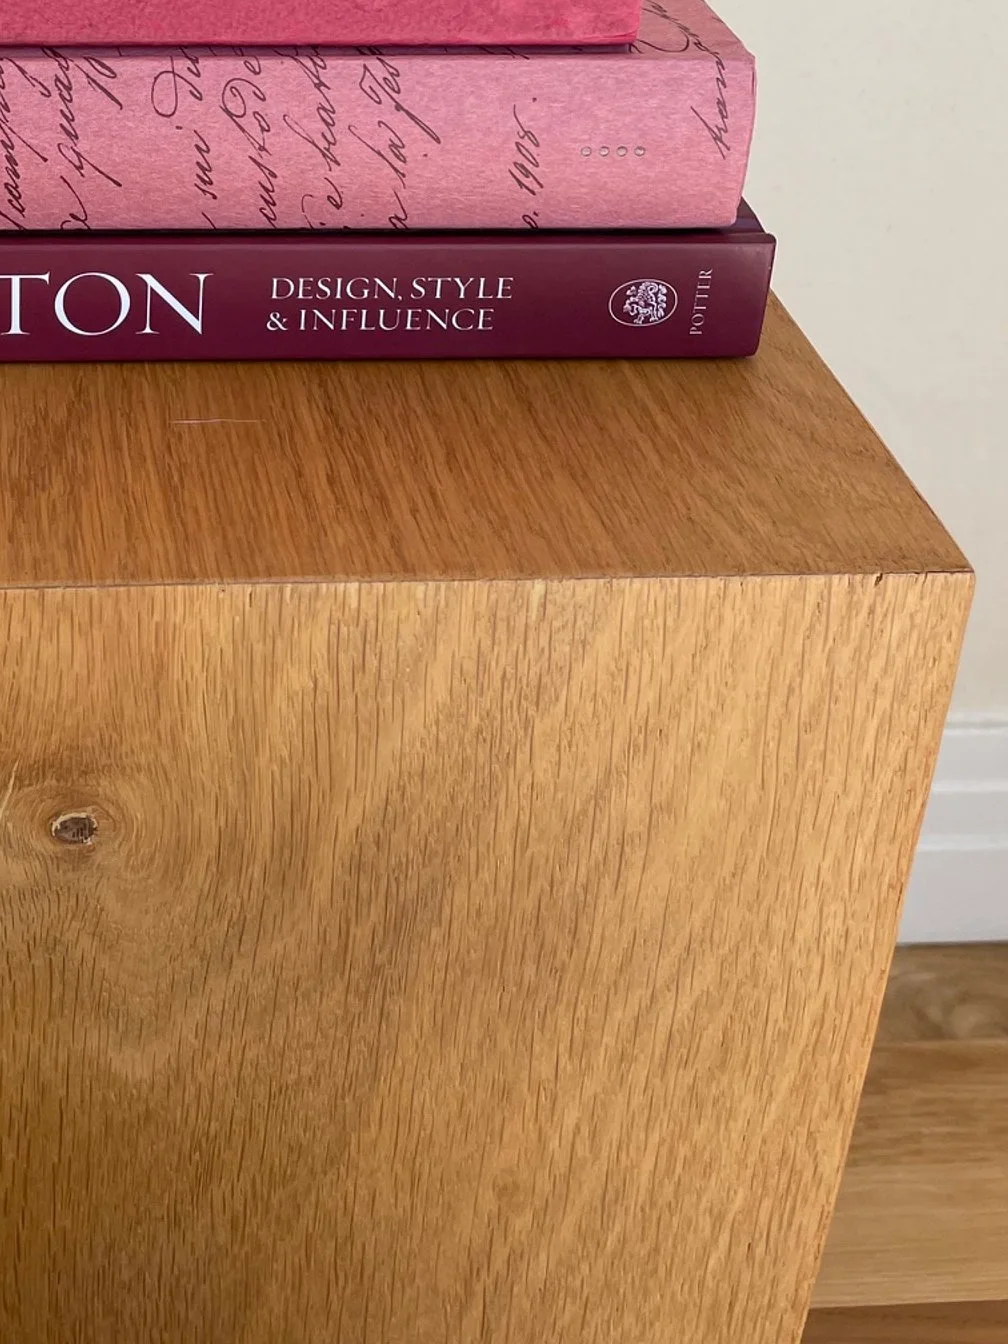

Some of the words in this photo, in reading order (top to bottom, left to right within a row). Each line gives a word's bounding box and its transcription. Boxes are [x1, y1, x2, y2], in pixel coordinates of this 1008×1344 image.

[271, 277, 403, 301] DESIGN,
[410, 276, 514, 300] STYLE
[689, 268, 713, 336] POTTER
[266, 311, 289, 331] &
[298, 308, 494, 331] INFLUENCE
